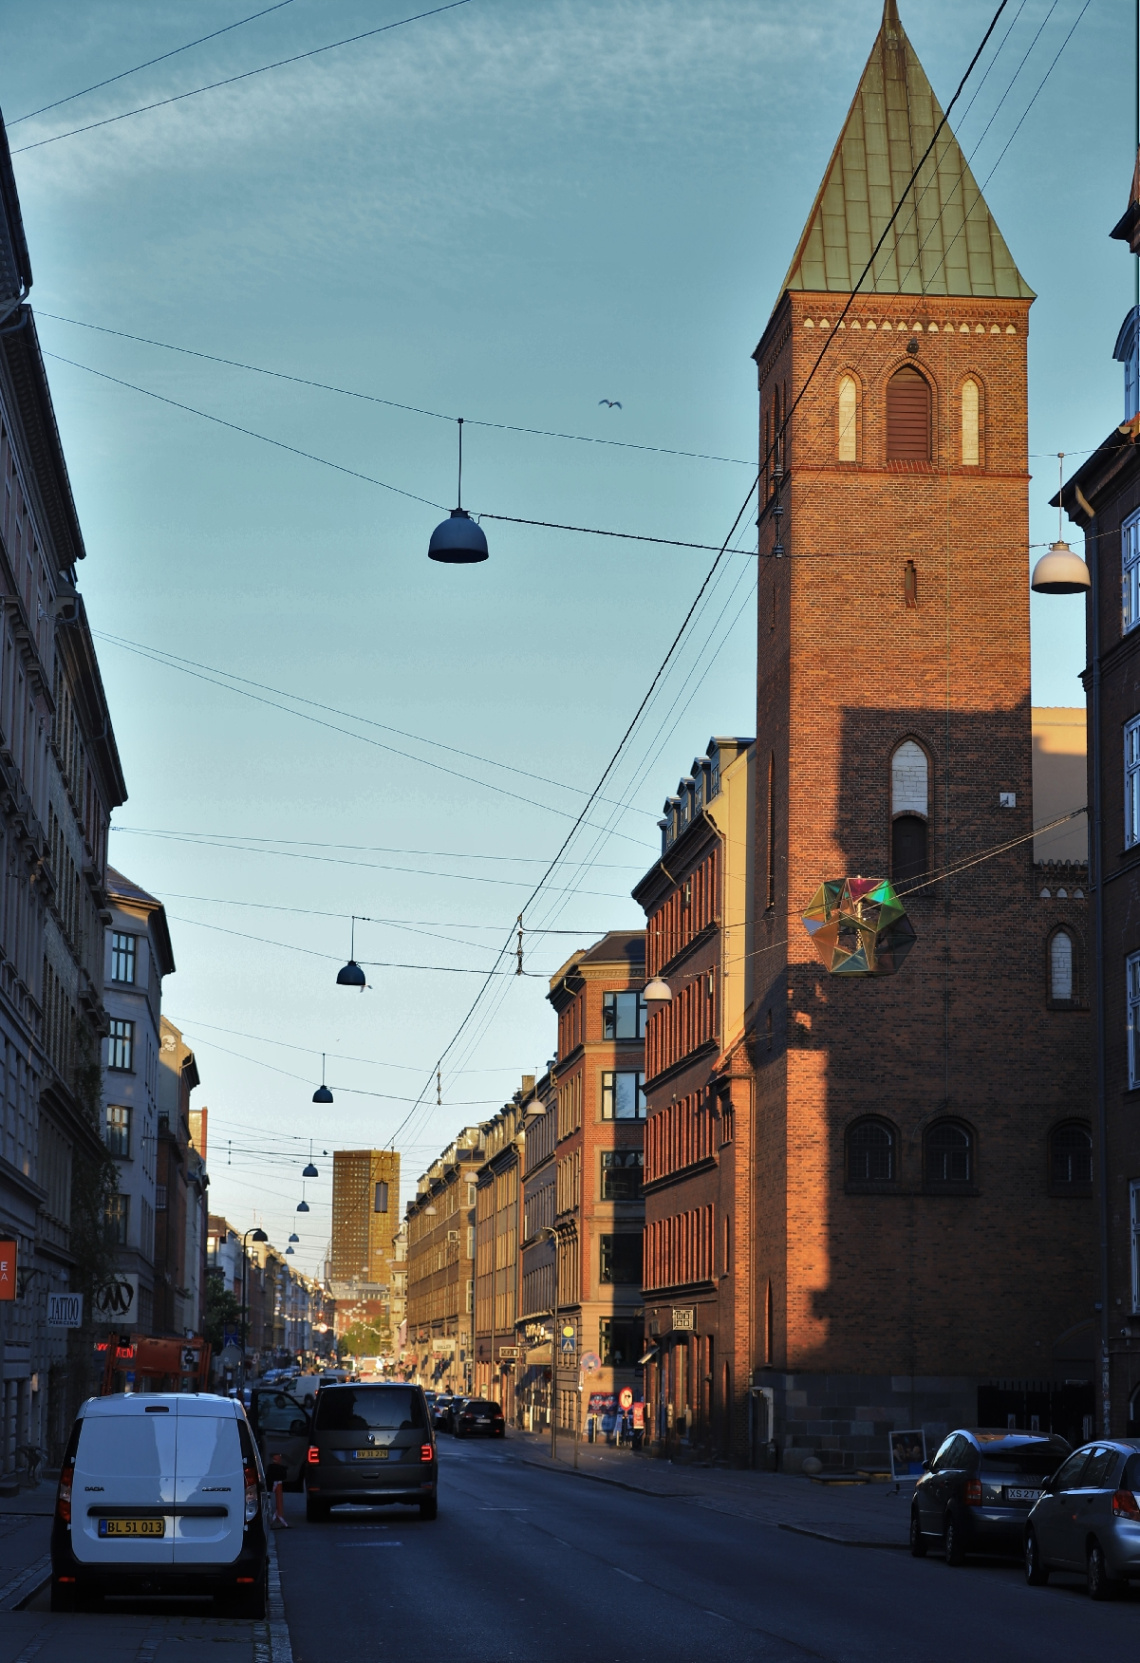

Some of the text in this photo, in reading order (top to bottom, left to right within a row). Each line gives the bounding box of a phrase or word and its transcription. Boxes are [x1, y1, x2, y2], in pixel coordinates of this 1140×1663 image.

[50, 1297, 79, 1321] TATTOO
[1024, 1490, 1034, 1498] 27
[107, 1522, 162, 1533] BL 51 013
